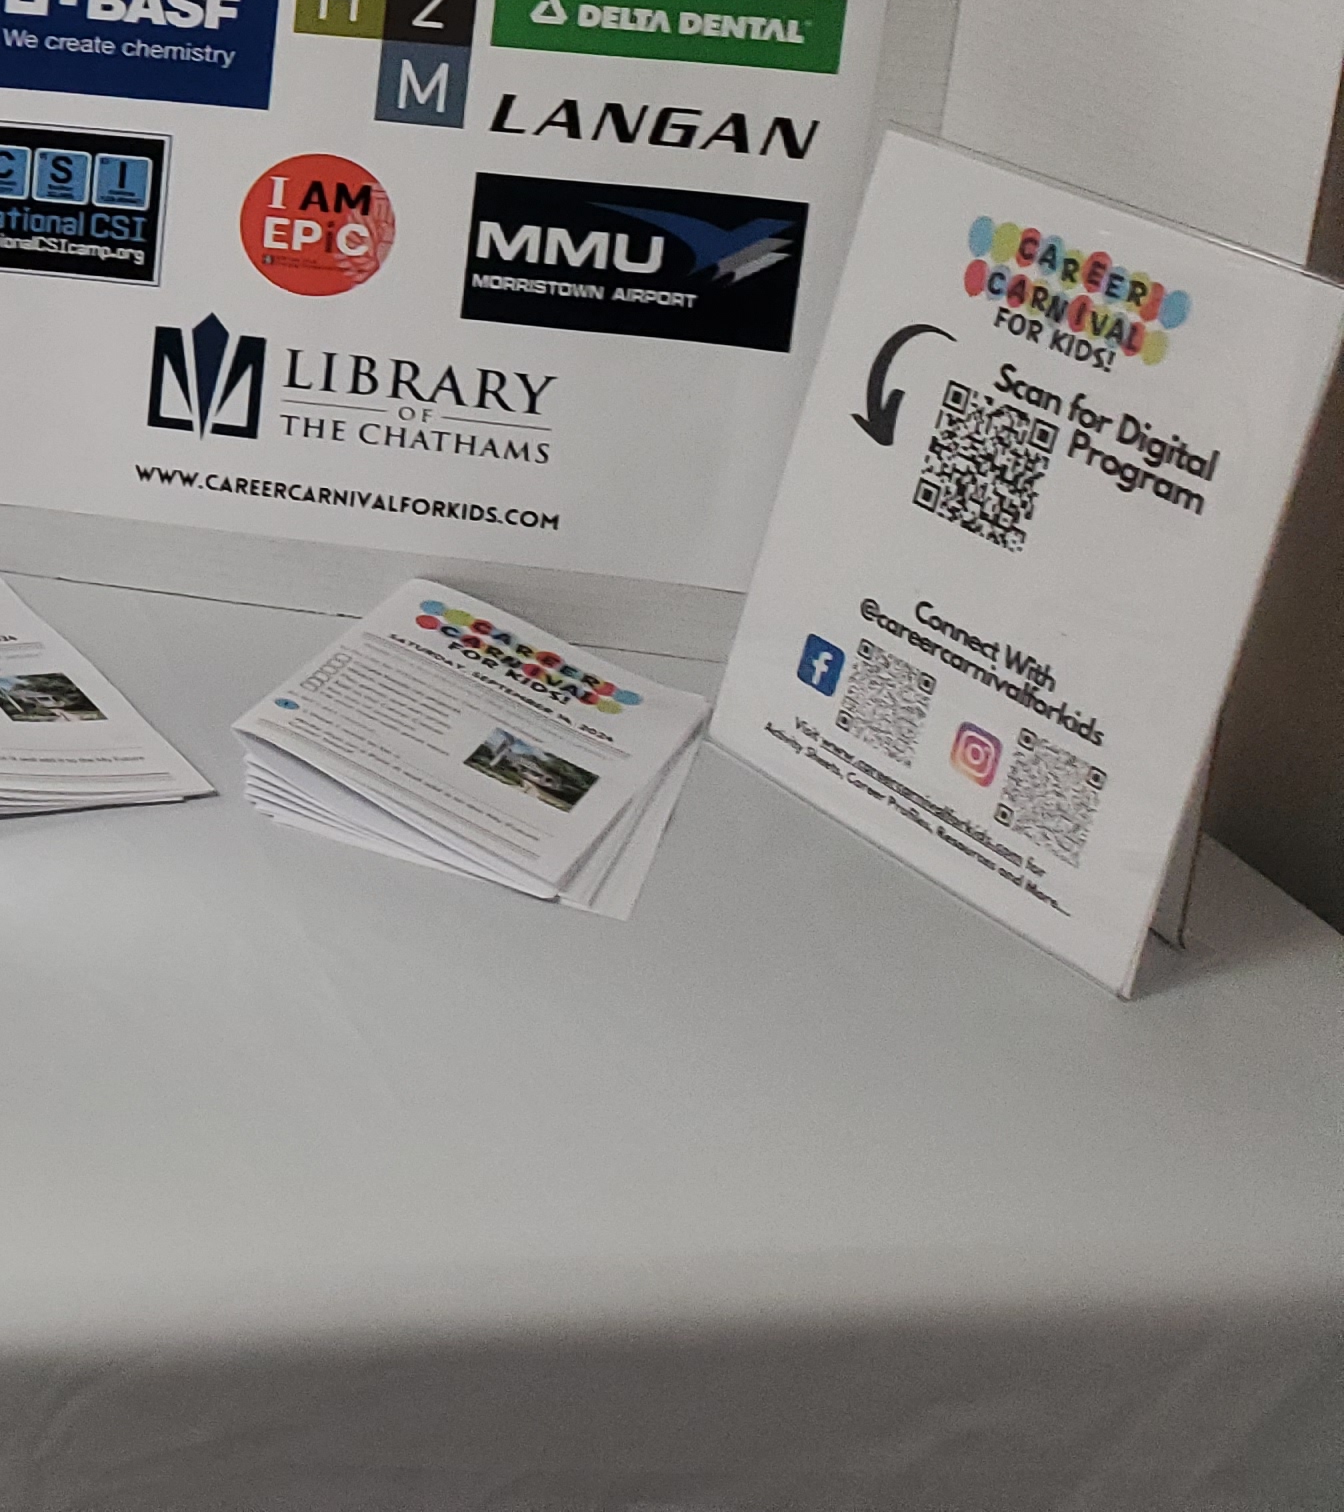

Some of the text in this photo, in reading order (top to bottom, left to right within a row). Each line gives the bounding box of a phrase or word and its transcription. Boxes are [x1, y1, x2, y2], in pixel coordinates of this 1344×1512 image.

[2, 28, 237, 69] We create chemistry
[577, 2, 806, 45] DELTA DENTAL
[488, 93, 820, 159] LANGAN
[267, 175, 373, 216] I AM
[90, 212, 148, 243] CSI
[474, 220, 665, 274] MMU
[471, 273, 698, 310] MORRISTOWN AIRPORT
[1018, 234, 1150, 308] CAREER
[986, 270, 1142, 354] CARNIVAL
[993, 306, 1118, 374] FOR KIDS!
[281, 347, 559, 417] LIBRARY
[279, 413, 551, 465] THE CHATHAMS
[397, 404, 434, 424] OF
[993, 363, 1221, 483] Scan for Digital
[134, 463, 560, 532] WWW.CAREERCARNIVALFORKIDS.COM
[1067, 430, 1206, 516] Program
[446, 640, 501, 670] FOR
[914, 600, 1057, 693] Connect With
